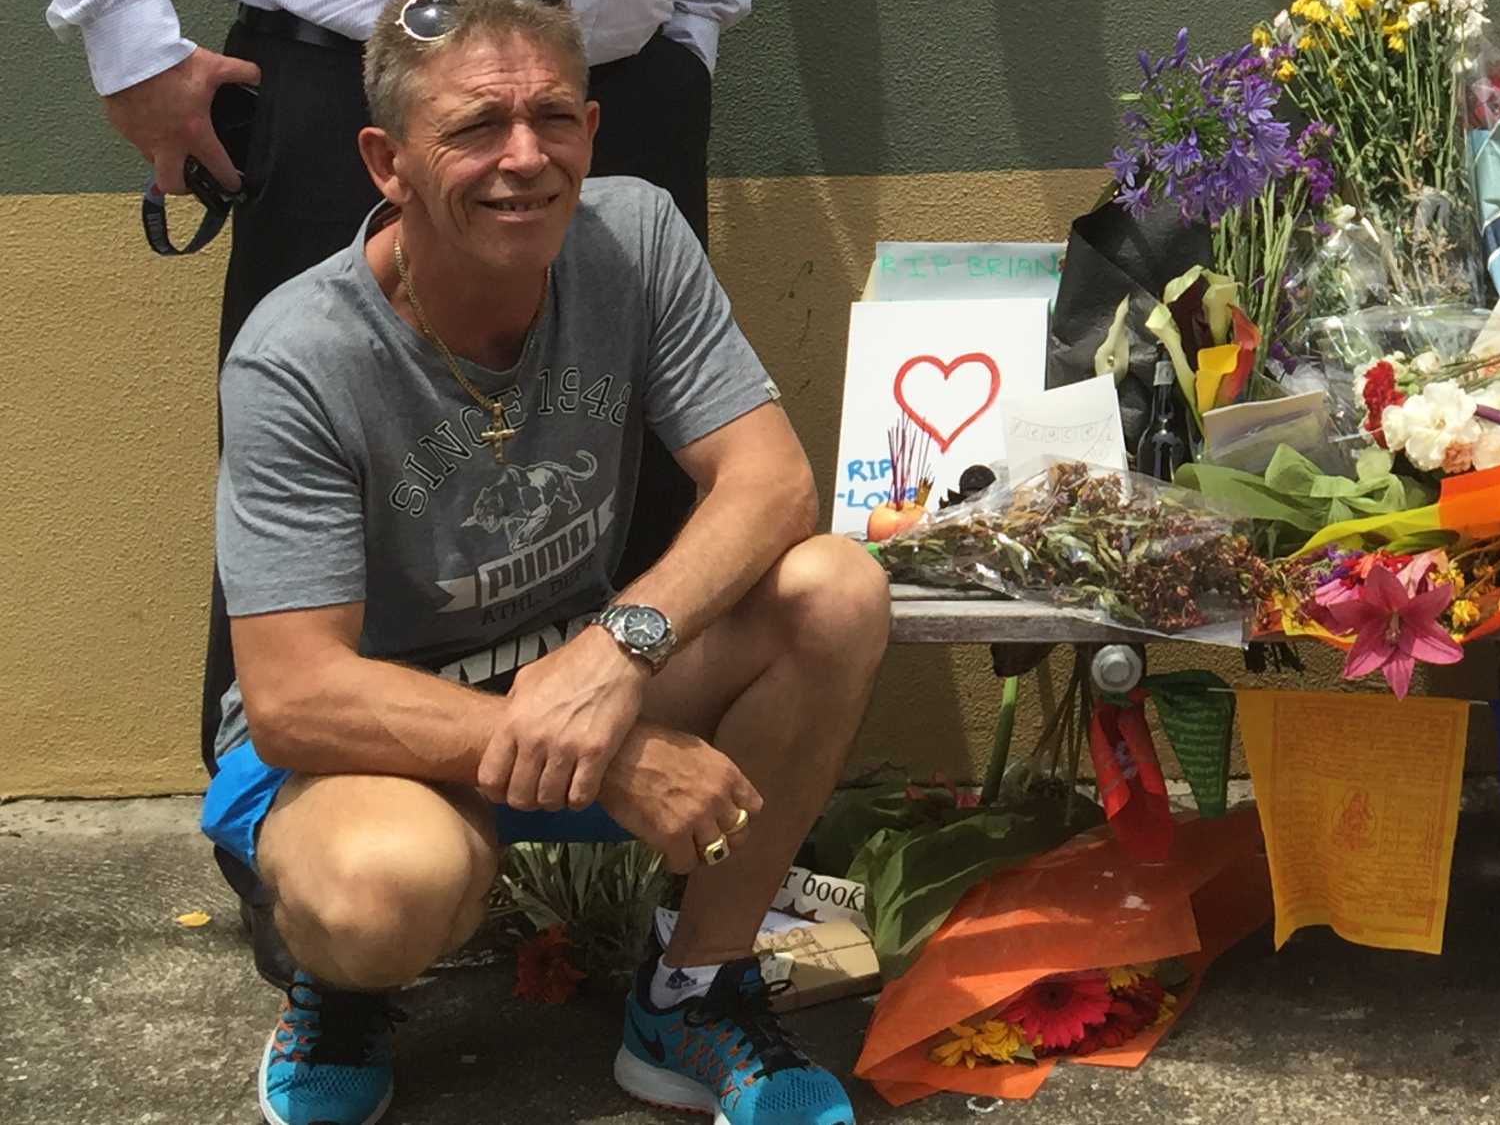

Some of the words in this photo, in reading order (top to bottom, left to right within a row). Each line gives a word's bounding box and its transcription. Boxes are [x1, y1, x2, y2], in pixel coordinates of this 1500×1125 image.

[880, 253, 952, 278] RIP
[389, 384, 529, 518] SINCE
[537, 365, 633, 428] 1948
[847, 458, 893, 482] RIP
[486, 519, 592, 602] PUMA
